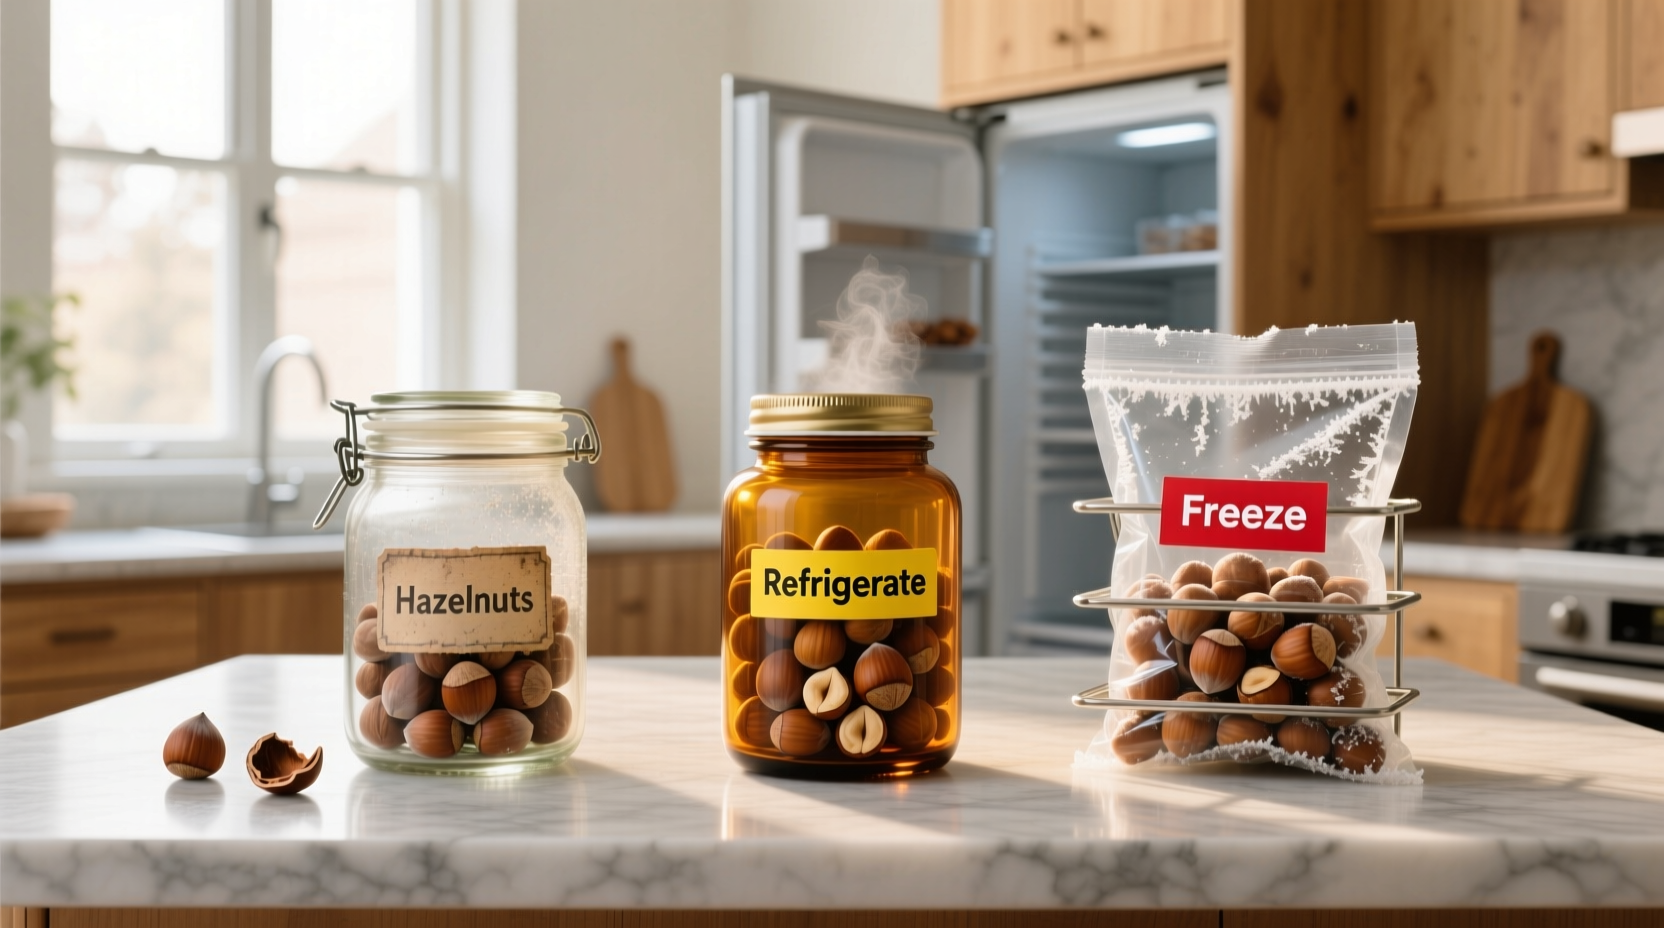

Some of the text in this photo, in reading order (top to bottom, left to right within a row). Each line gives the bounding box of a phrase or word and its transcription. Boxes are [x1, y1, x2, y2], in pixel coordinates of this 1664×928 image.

[1182, 494, 1307, 531] Freeze
[396, 584, 534, 615] Hazelnuts
[764, 567, 926, 606] Refrigerate
